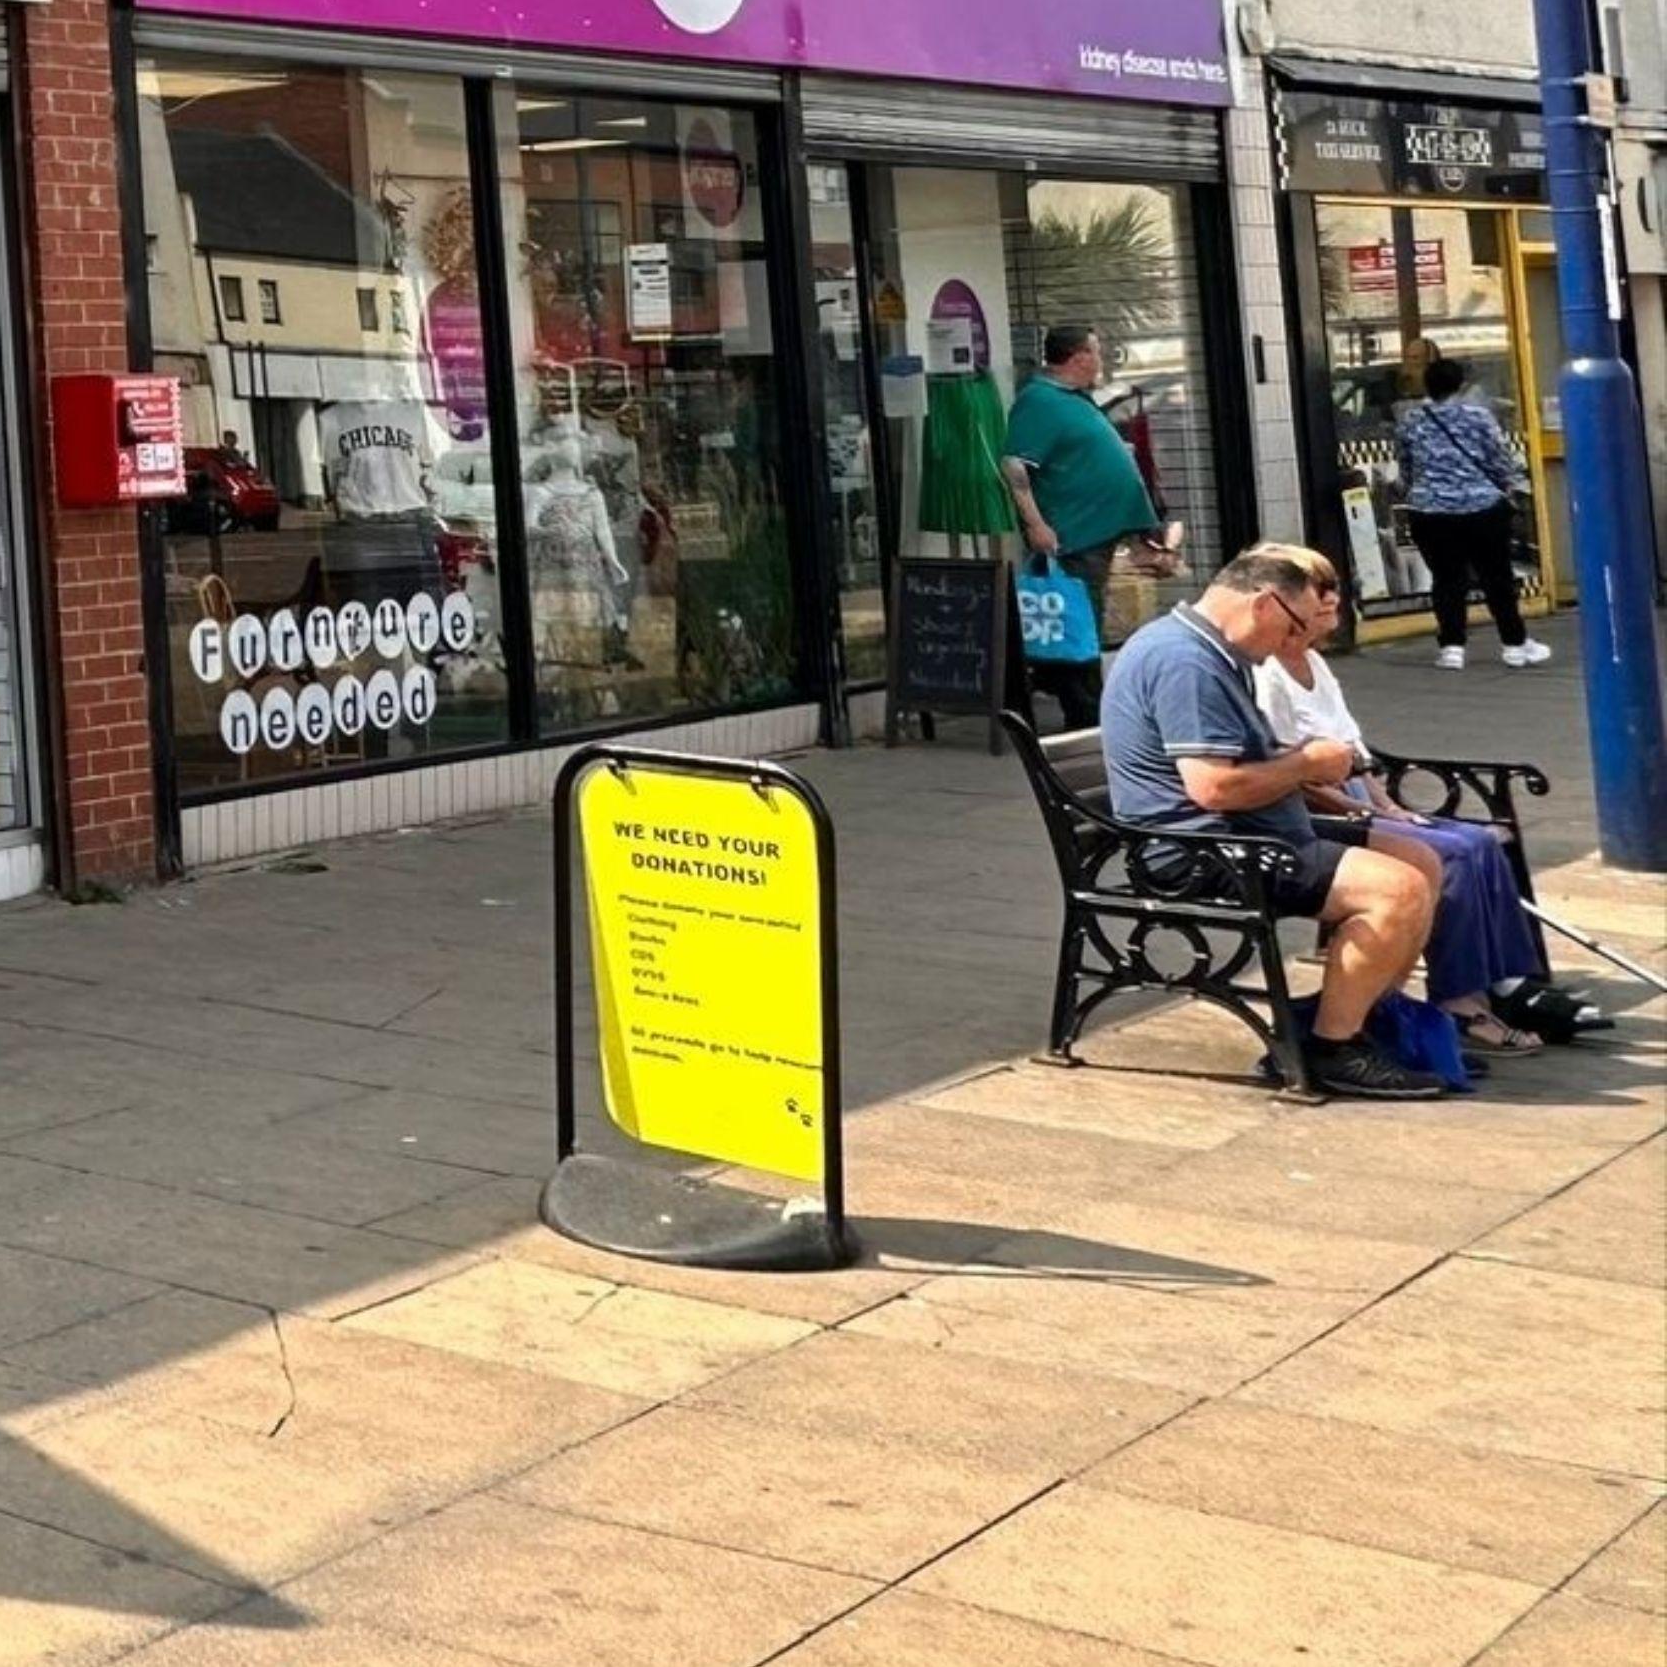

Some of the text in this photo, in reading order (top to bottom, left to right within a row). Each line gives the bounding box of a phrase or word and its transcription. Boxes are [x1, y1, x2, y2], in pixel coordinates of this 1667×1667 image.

[197, 602, 469, 672] Furniture
[227, 674, 432, 748] needed
[613, 821, 782, 860] WE NEED YOUR
[631, 852, 768, 887] DONATIONS!
